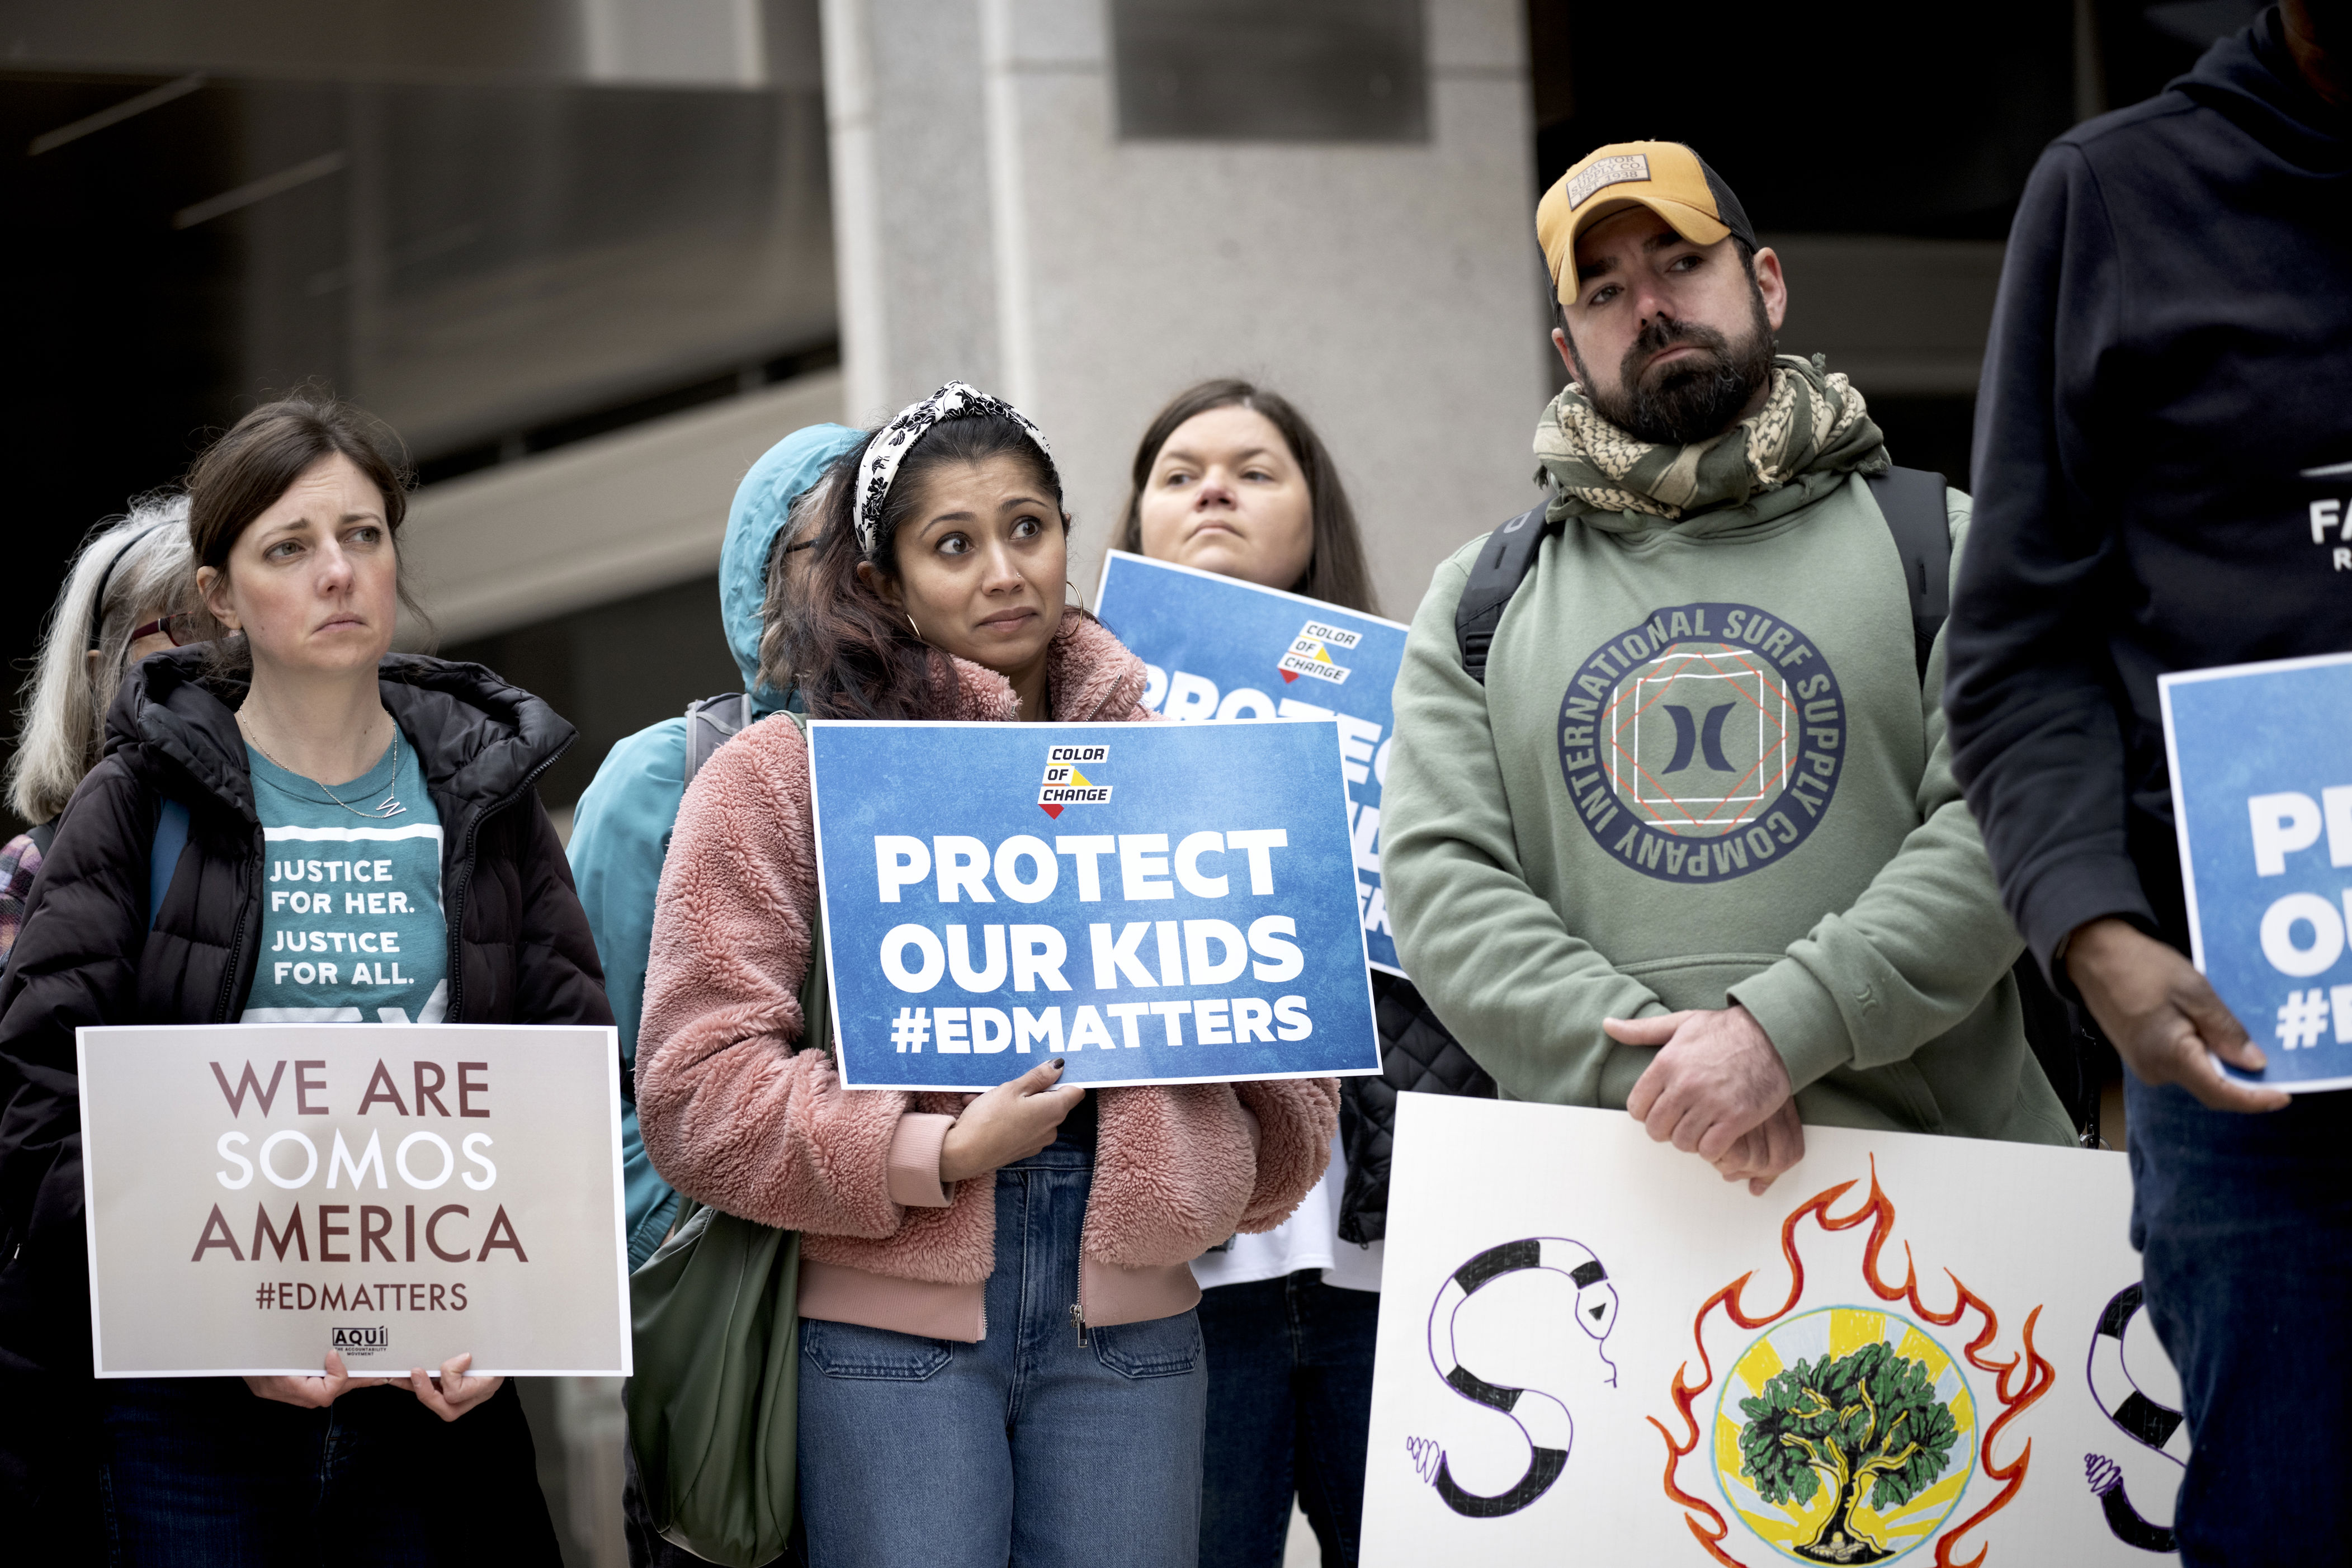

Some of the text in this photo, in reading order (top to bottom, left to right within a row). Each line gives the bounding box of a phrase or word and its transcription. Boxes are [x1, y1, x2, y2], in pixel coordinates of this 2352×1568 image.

[1571, 164, 1616, 195] SUPPLY
[1574, 156, 1635, 182] TRACTOR
[1579, 171, 1638, 199] EST. 1938
[1295, 641, 1316, 652] OF
[1306, 625, 1356, 644] COLOR
[1284, 657, 1344, 680] CHANGE
[1052, 748, 1104, 760] COLOR
[1563, 608, 1840, 877] INTERNATIONAL SURF SUPPLY COMPANY
[1047, 769, 1069, 781] OF
[1043, 789, 1108, 801] CHANGE
[270, 859, 393, 882] JUSTICE
[874, 829, 1288, 904] PROTECT
[272, 891, 415, 914] FOR HER.
[271, 931, 400, 953] JUSTICE
[880, 915, 1304, 993] OUR KIDS
[275, 962, 414, 985] FOR ALL.
[891, 995, 1313, 1054] #EDMATTERS
[209, 1058, 490, 1118] WE ARE
[216, 1127, 497, 1191] SOMOS
[191, 1201, 529, 1263] AMERICA
[255, 1282, 468, 1312] #EDMATTERS
[335, 1325, 384, 1346] AQUÍ
